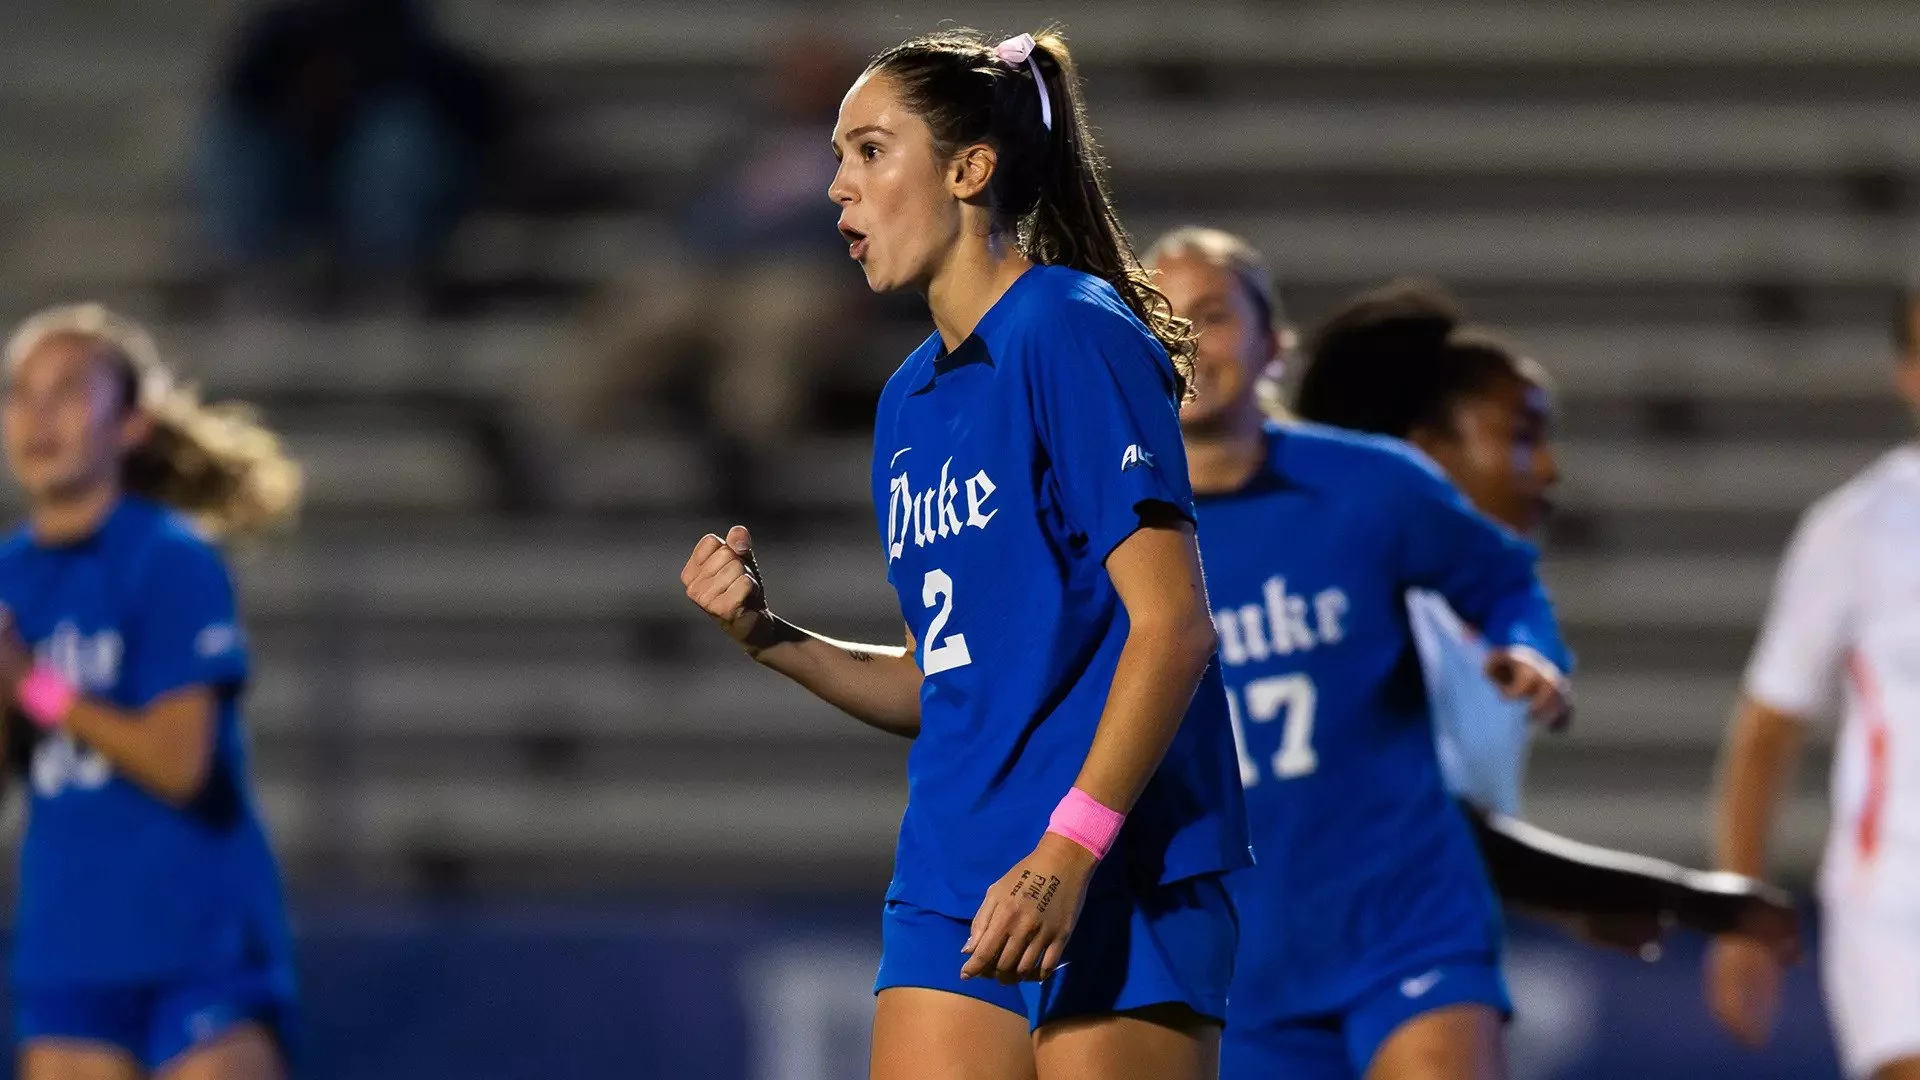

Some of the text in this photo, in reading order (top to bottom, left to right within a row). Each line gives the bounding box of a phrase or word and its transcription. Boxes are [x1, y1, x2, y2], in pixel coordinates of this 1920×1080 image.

[888, 456, 998, 564] Duke
[922, 568, 972, 676] 2
[1216, 574, 1349, 666] uke
